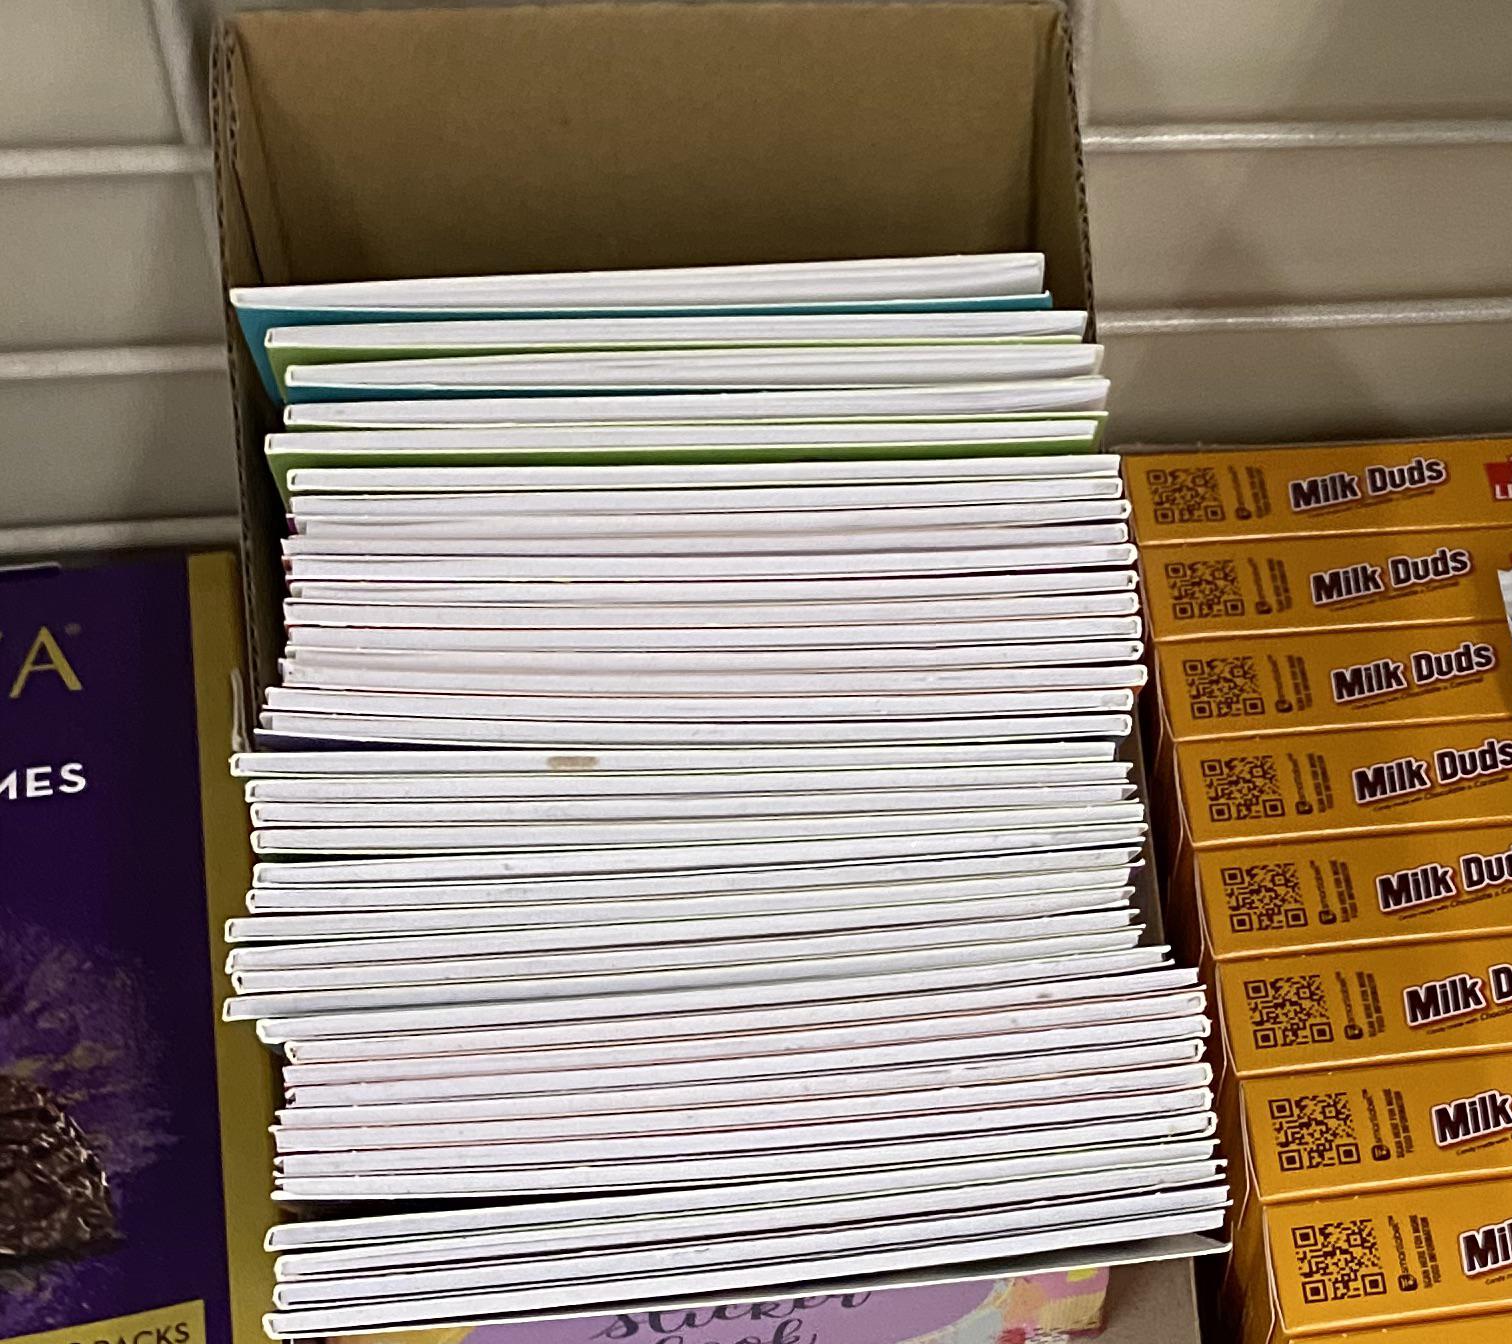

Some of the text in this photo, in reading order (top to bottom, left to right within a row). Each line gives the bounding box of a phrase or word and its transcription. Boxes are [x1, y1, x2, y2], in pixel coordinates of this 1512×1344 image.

[1289, 471, 1362, 512] Milk
[1365, 457, 1447, 497] Duds
[1310, 563, 1385, 606] Milk
[1388, 546, 1472, 588] Duds
[1331, 659, 1408, 704] Milk
[1411, 641, 1496, 685] Duds
[1352, 756, 1431, 805] Milk
[1376, 862, 1457, 913] Milk
[1403, 973, 1487, 1026] Milk
